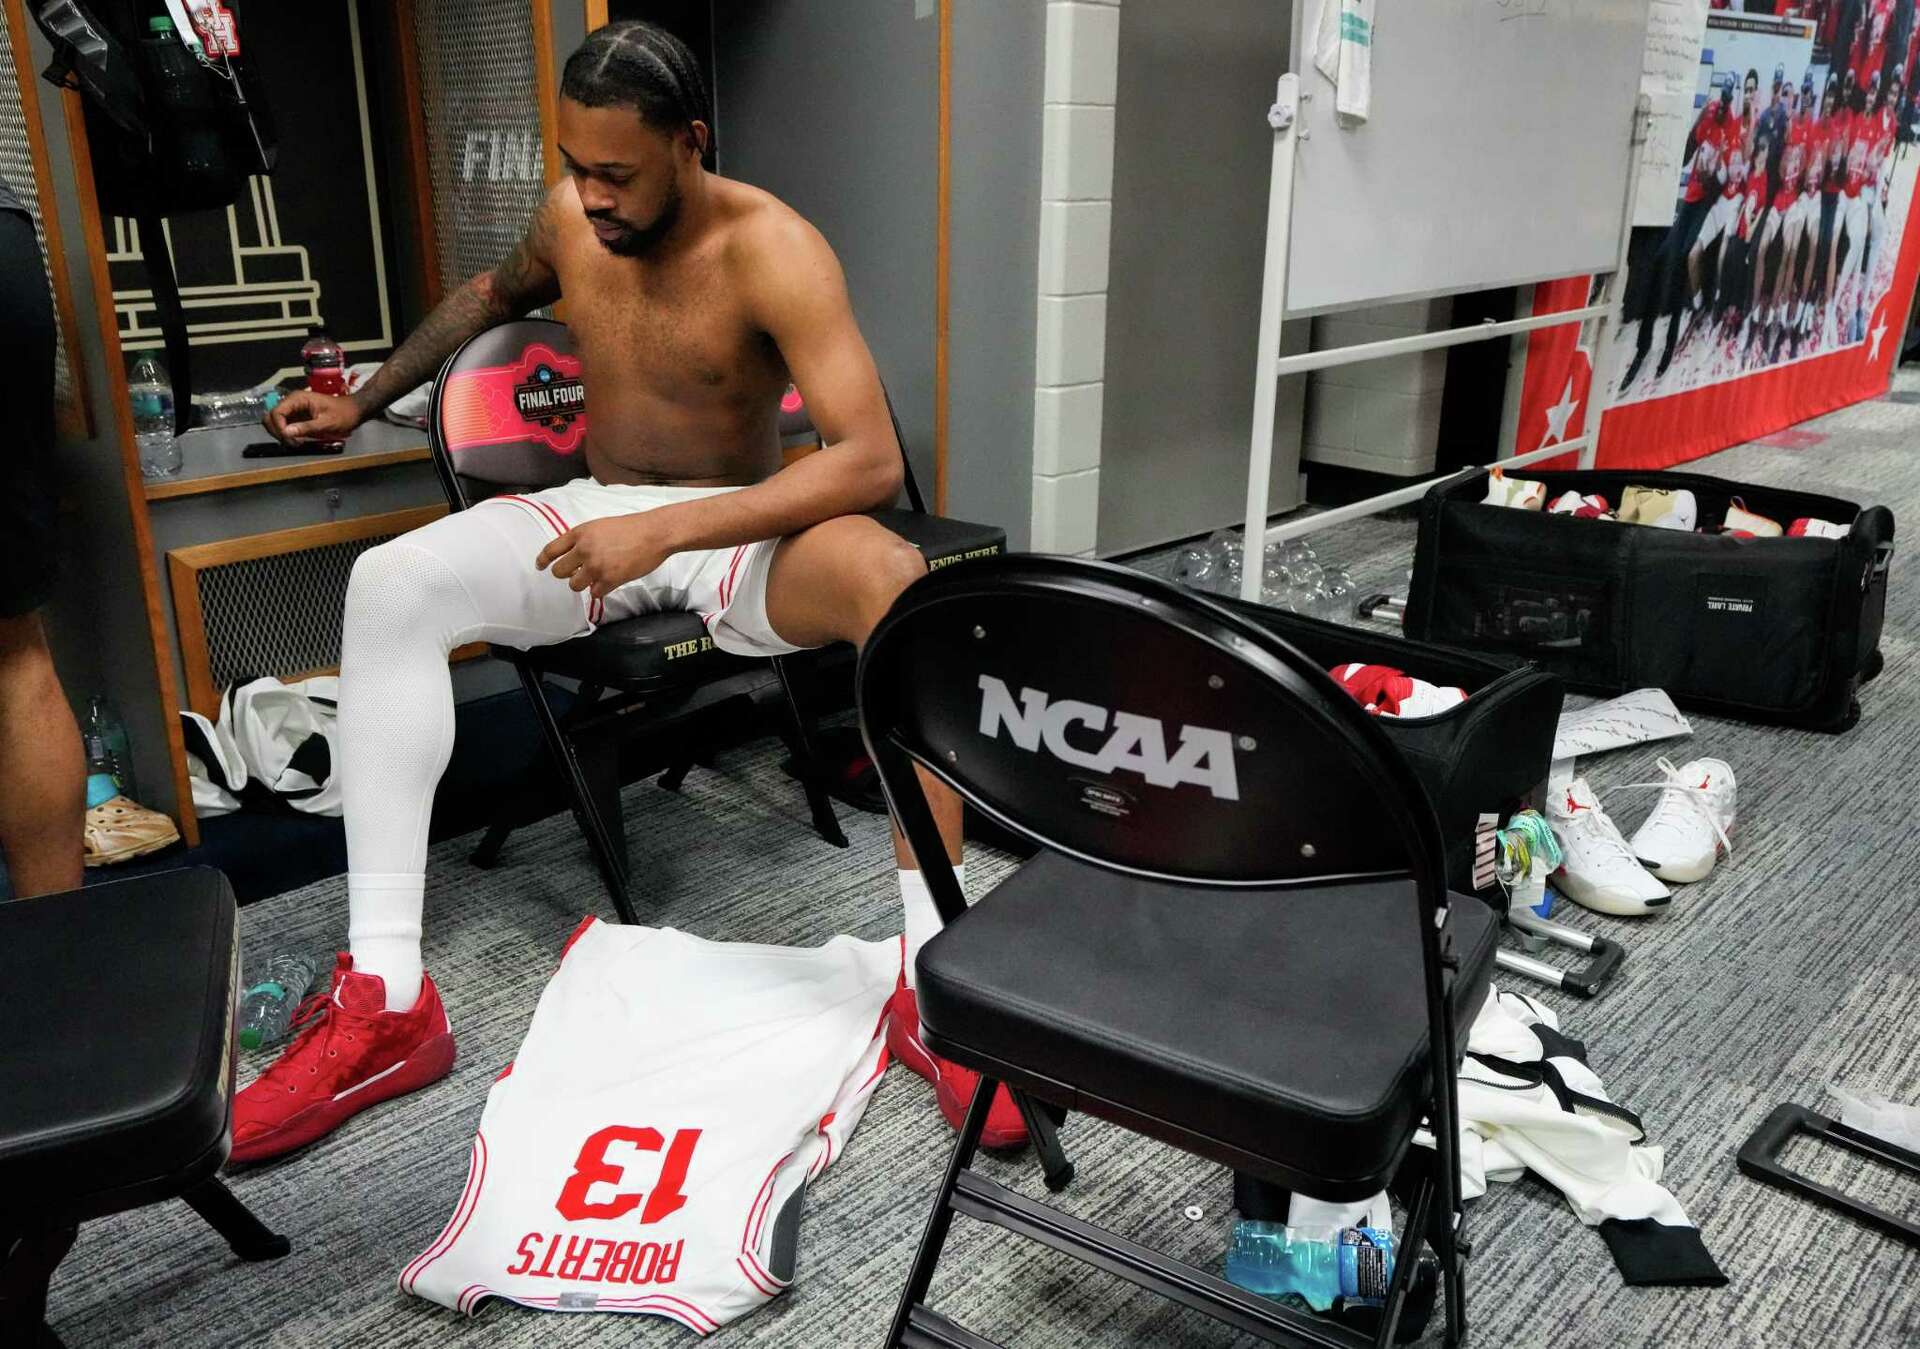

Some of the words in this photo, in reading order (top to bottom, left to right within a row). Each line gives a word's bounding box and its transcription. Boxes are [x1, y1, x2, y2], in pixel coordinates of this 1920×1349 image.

[518, 390, 554, 410] FINAL
[552, 385, 585, 405] FOUR
[929, 554, 963, 572] ENDS
[1727, 602, 1753, 612] PRIVATE
[664, 639, 698, 660] THE
[978, 673, 1240, 801] NCAA
[555, 1125, 703, 1224] 13
[507, 1232, 684, 1284] ROBERTS
